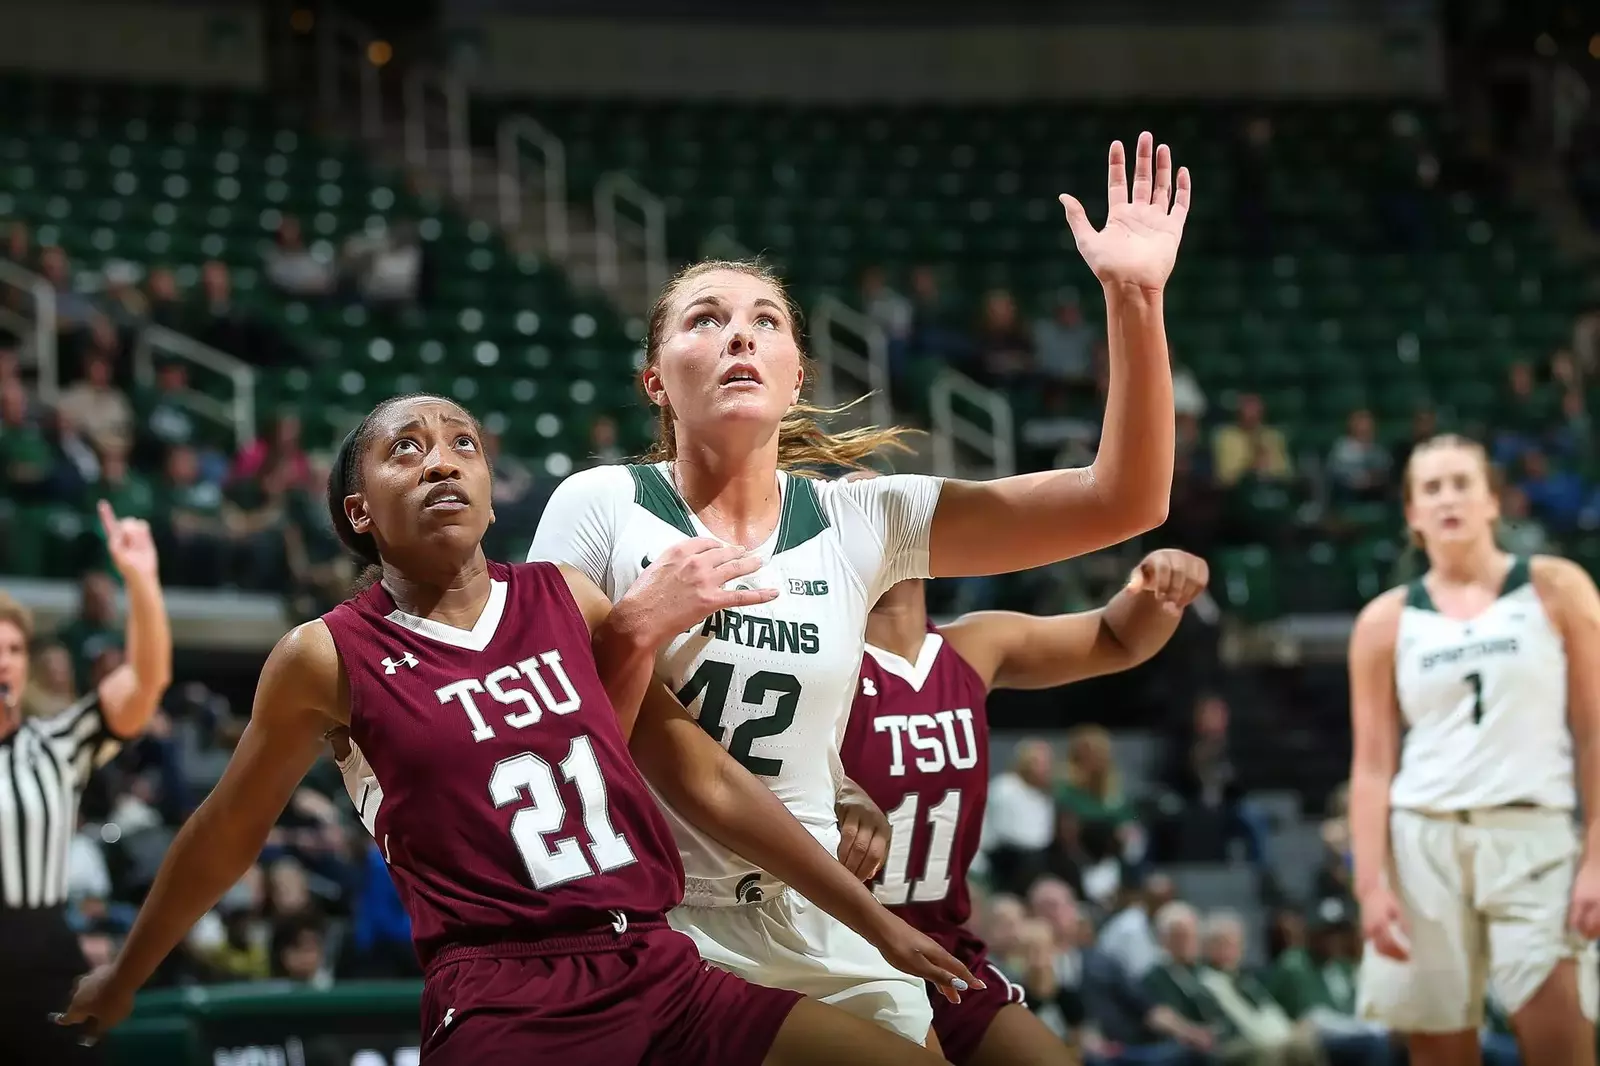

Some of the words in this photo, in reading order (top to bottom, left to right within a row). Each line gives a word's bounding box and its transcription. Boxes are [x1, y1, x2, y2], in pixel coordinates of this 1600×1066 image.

[686, 608, 820, 655] ARTANS
[434, 649, 582, 743] TSU
[676, 659, 802, 777] 42
[873, 708, 978, 777] TSU
[1463, 670, 1484, 725] 1
[488, 735, 638, 891] 21
[871, 788, 962, 905] 11
